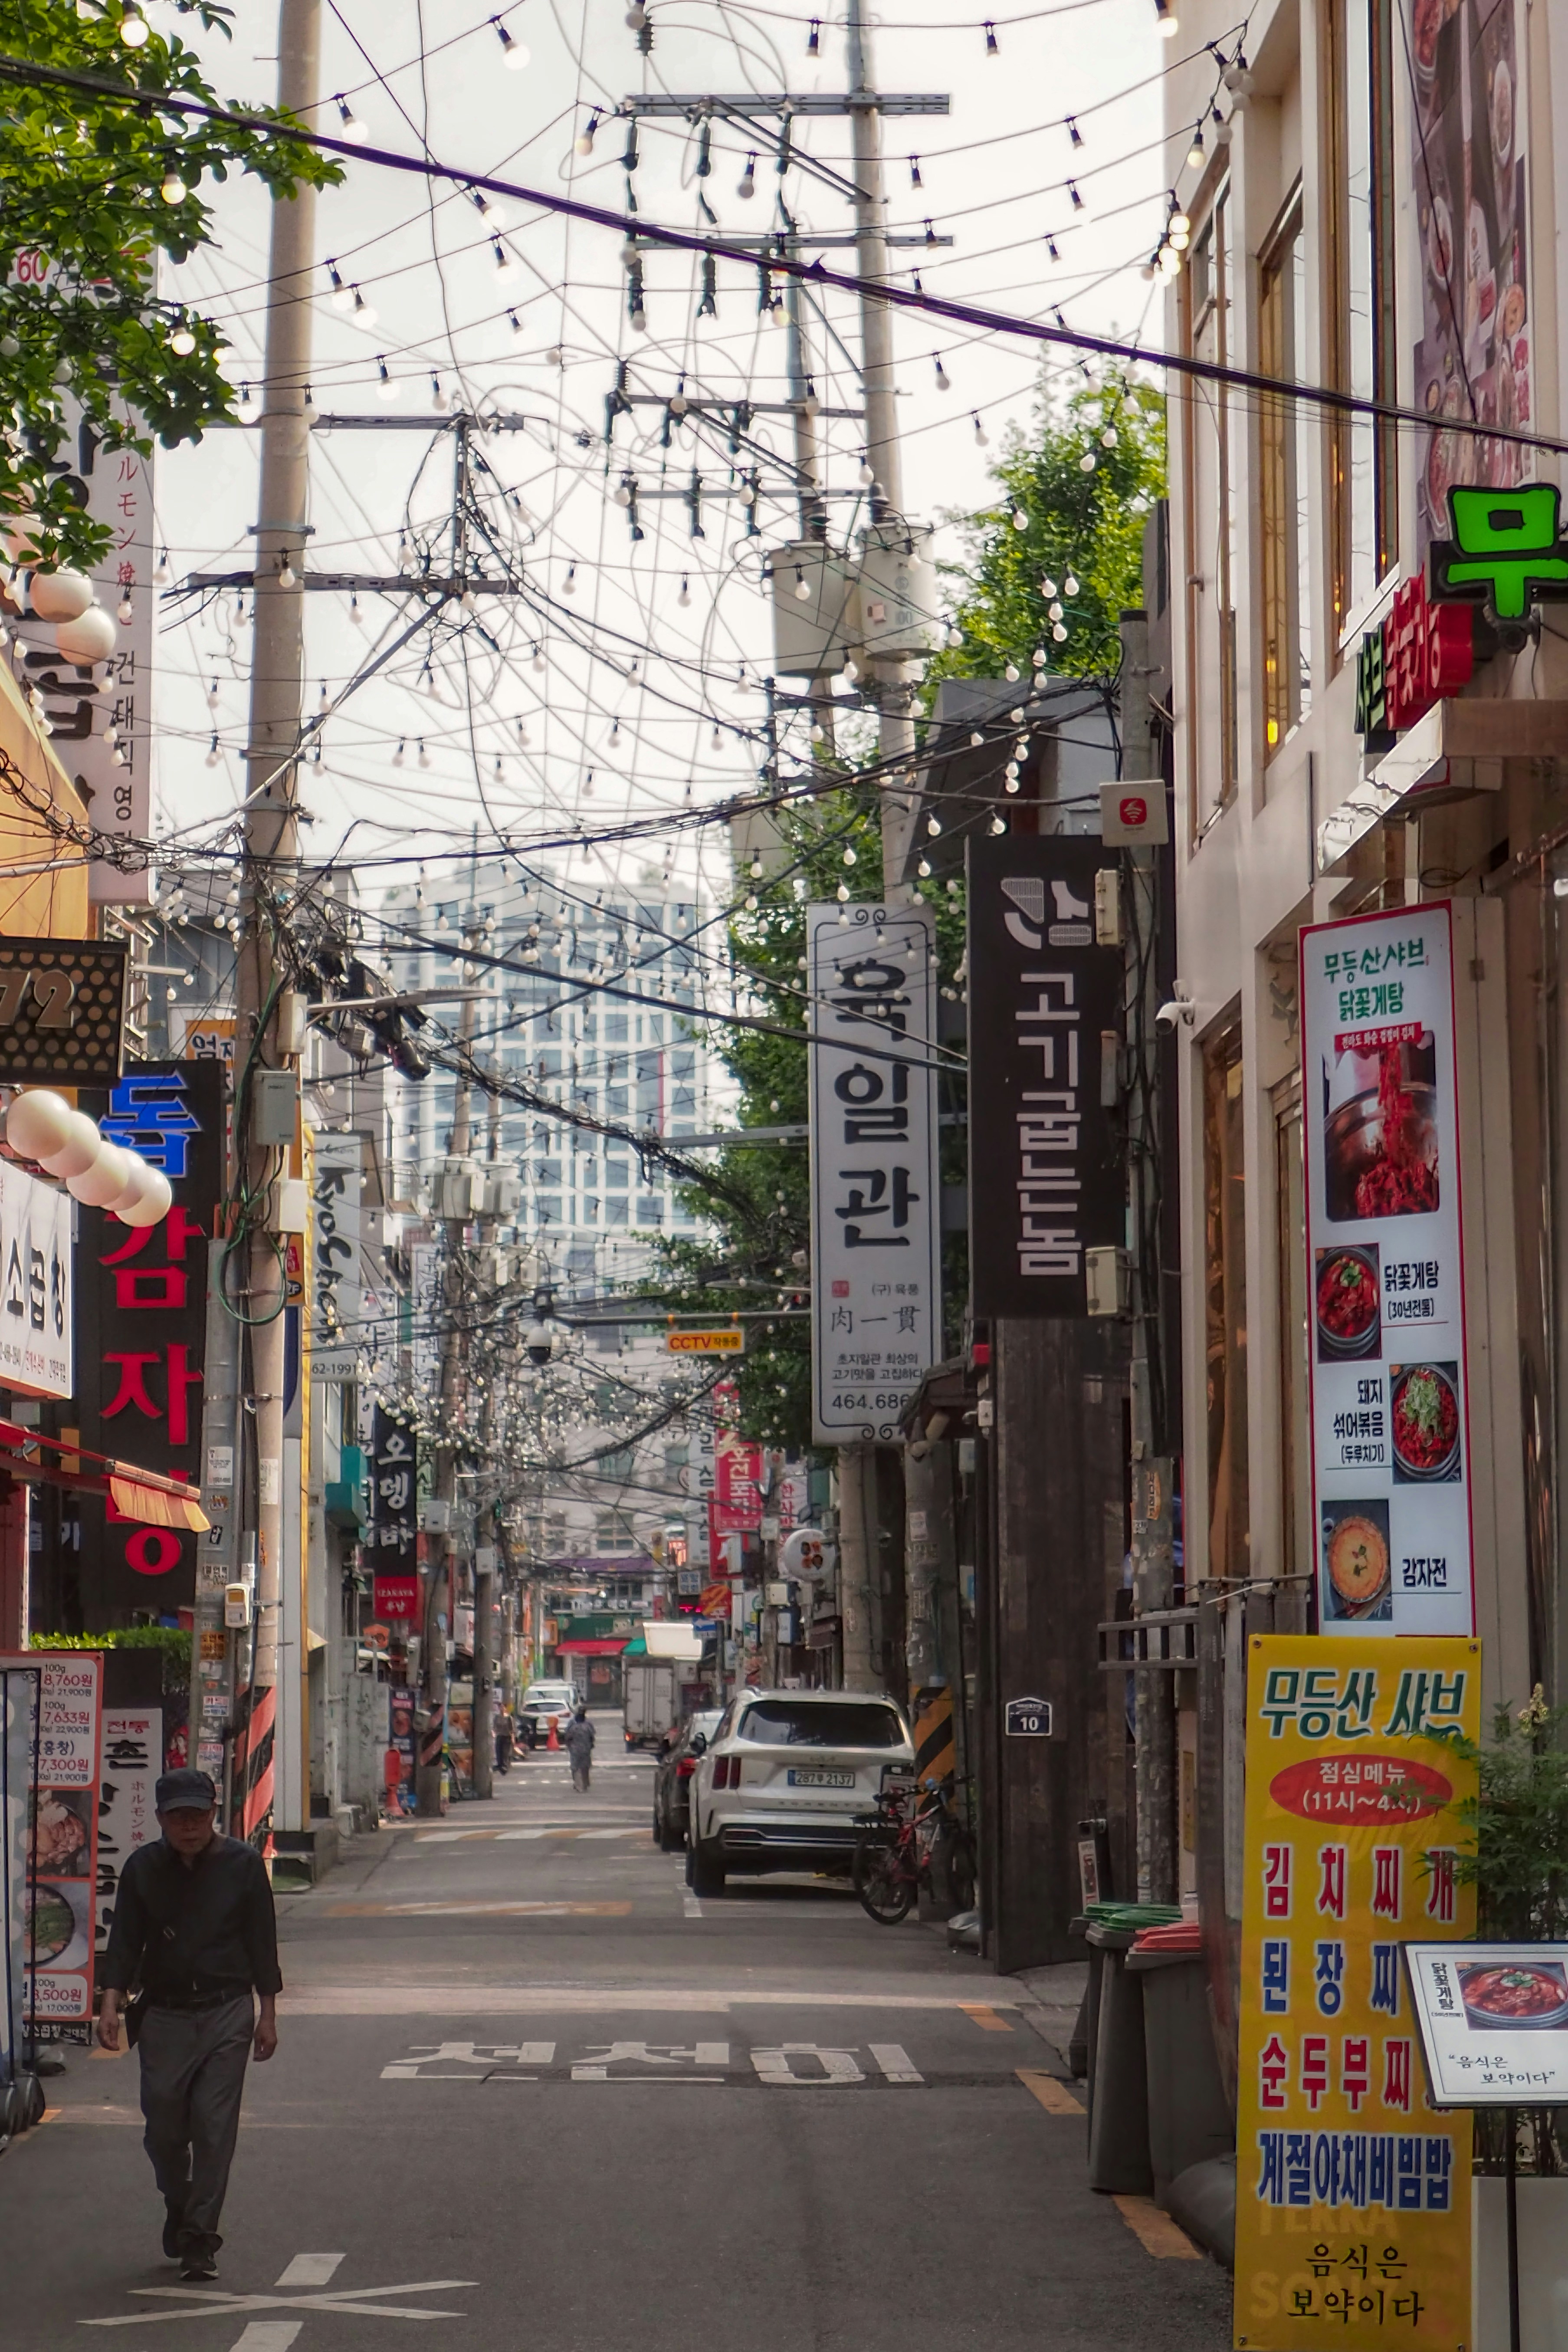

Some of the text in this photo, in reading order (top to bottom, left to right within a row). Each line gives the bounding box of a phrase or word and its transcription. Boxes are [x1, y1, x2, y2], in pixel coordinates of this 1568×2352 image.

[116, 419, 139, 626] ルモン焼
[113, 650, 135, 844] 건대직영
[1323, 937, 1426, 984] 무등산샤브
[1338, 981, 1404, 1022] 닭꽃게탕
[830, 957, 920, 1249] 육일관
[1016, 972, 1083, 1277] 고기굽는놈
[872, 1284, 891, 1298] (구)
[1384, 1260, 1440, 1292] 닭꽃게탕
[832, 1306, 921, 1334] 肉一貫
[1388, 1298, 1434, 1320] (30년전통)
[669, 1336, 739, 1350] CCTV 작동중
[837, 1353, 918, 1365] 초지일관 최상의
[832, 1368, 875, 1381] 고기맛을
[1358, 1378, 1383, 1405] 돼지
[1333, 1411, 1384, 1440] 섞어볶음
[377, 1434, 415, 1555] 오뎅바
[1402, 1557, 1447, 1588] 감자전
[44, 1674, 92, 1688] 8,760원
[45, 1664, 66, 1674] 100g
[44, 1711, 89, 1725] 7,633원
[45, 1702, 66, 1711] 100g
[1262, 1670, 1467, 1738] 무등산 샤브
[1020, 1716, 1038, 1731] 10
[39, 1759, 88, 1772] 7,300원
[826, 1774, 852, 1785] 2137
[1319, 1762, 1407, 1785] 점심메뉴
[1264, 1846, 1456, 1921] 김치찌개
[1263, 1942, 1397, 2014] 된장찌
[379, 2041, 925, 2085] 천천히
[1259, 2135, 1452, 2209] 계절야채비빔밥
[1306, 2243, 1407, 2280] 음식은
[1287, 2288, 1425, 2327] 보약이다
